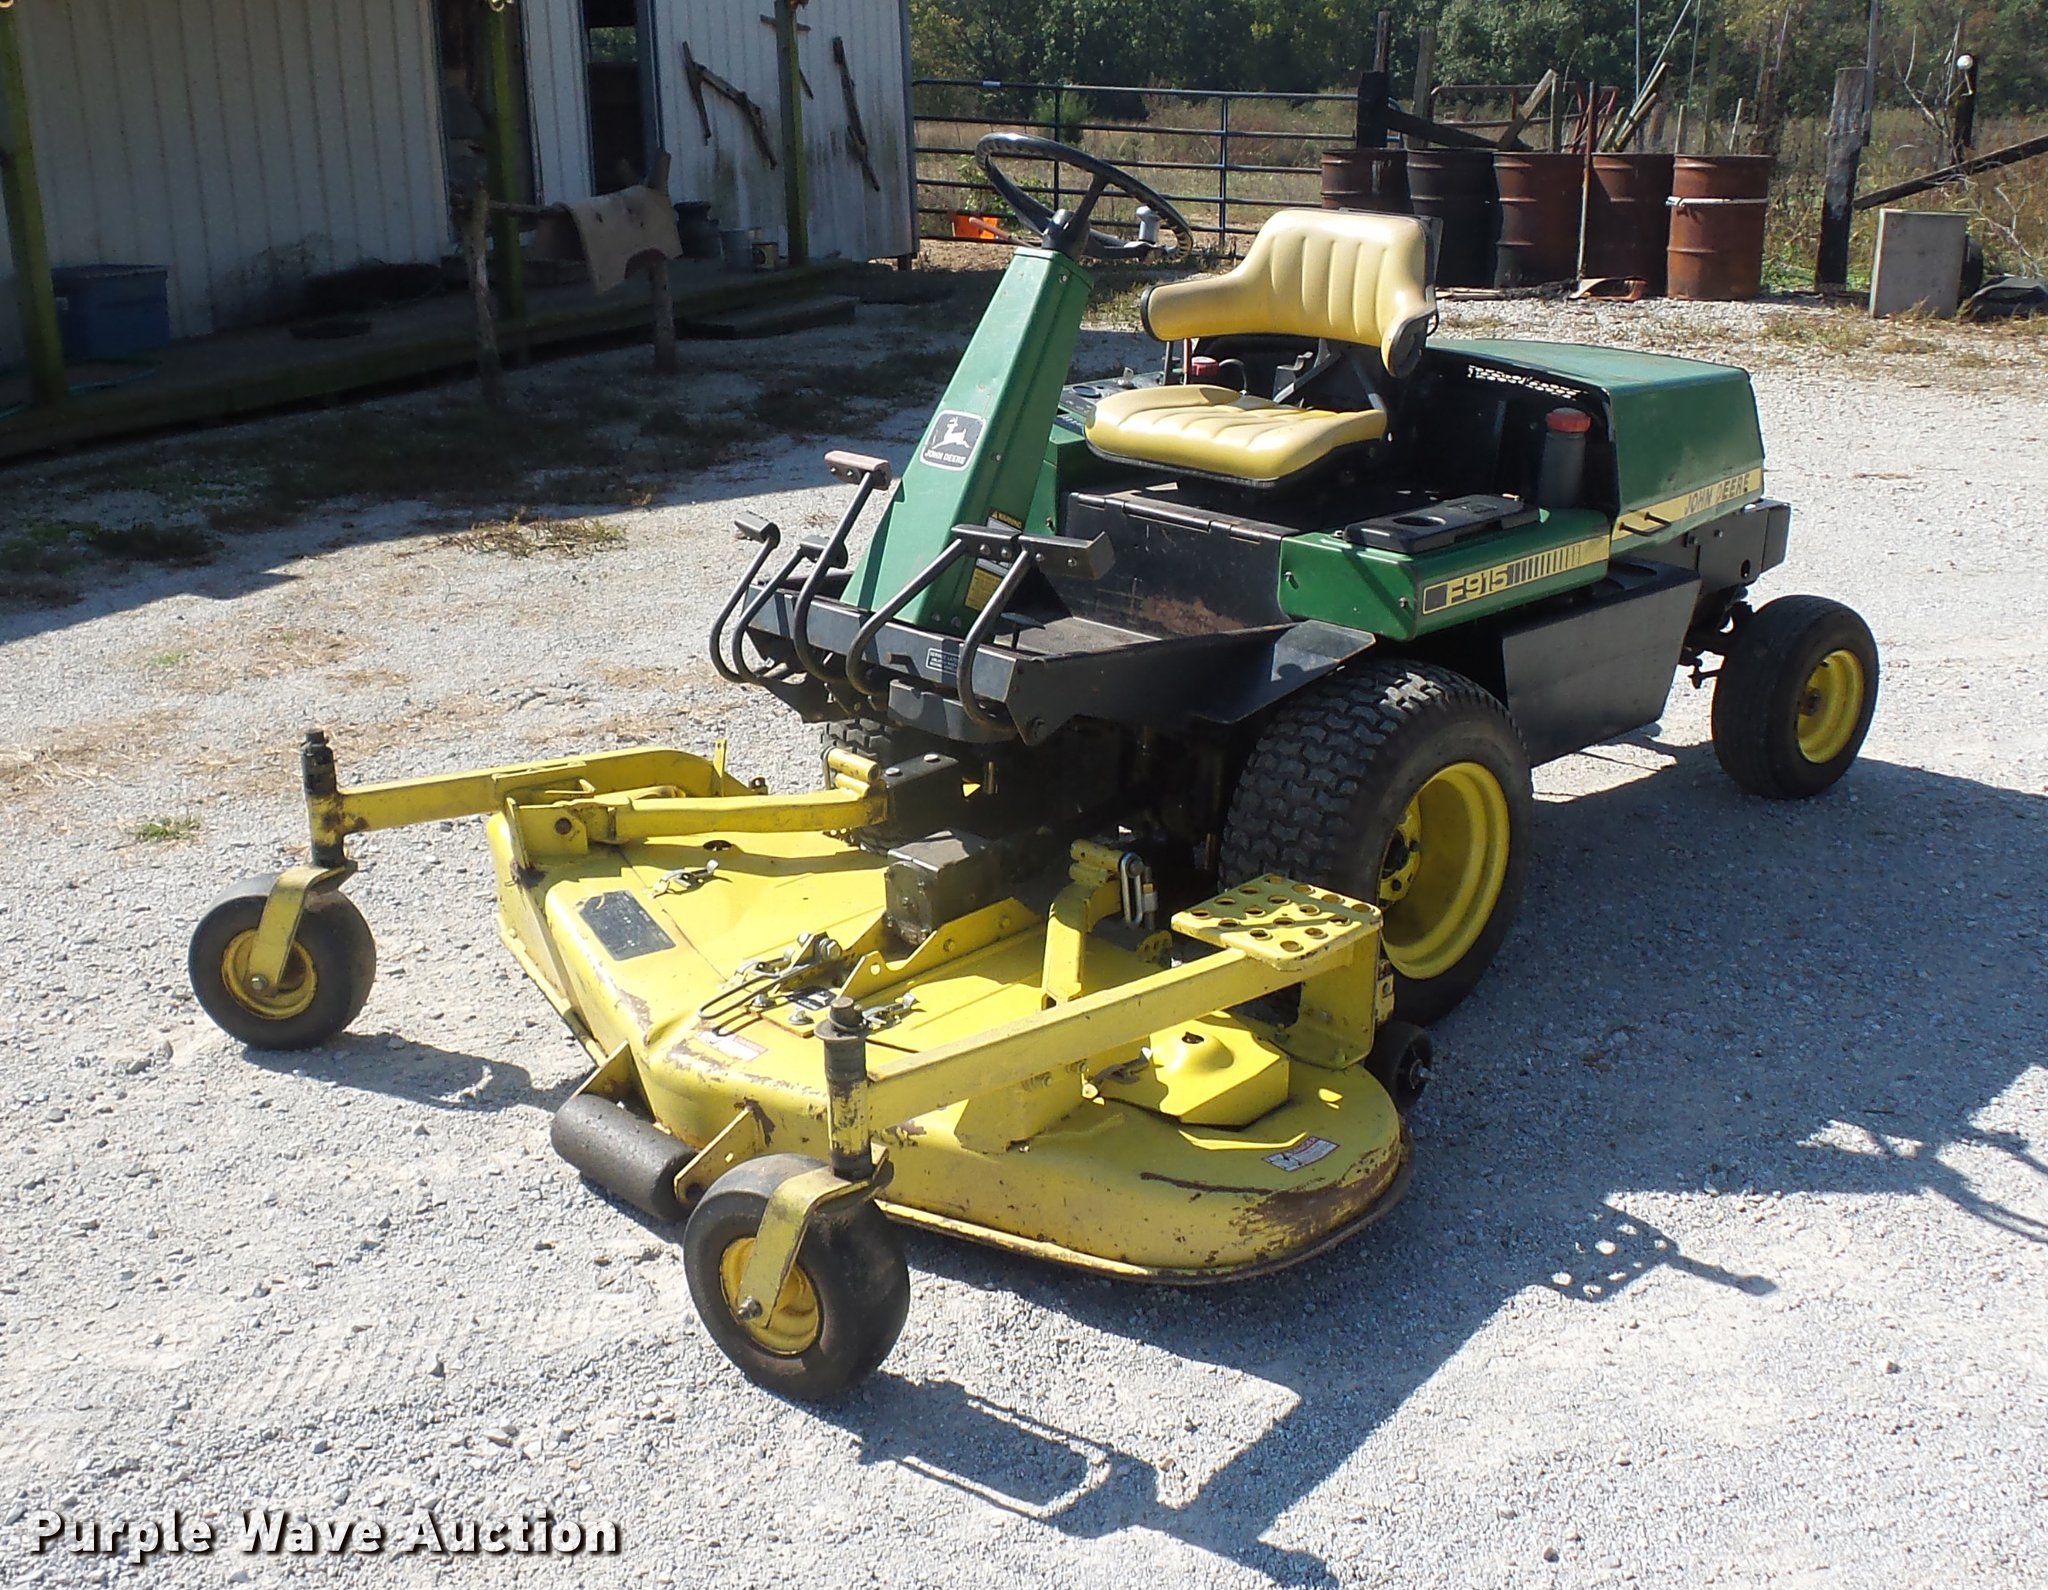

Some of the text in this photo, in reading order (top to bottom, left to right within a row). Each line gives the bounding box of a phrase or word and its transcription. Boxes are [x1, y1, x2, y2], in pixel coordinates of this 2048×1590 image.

[924, 449, 967, 465] JOHN DEERE
[1684, 487, 1713, 515] JOHN
[1446, 564, 1508, 606] F915
